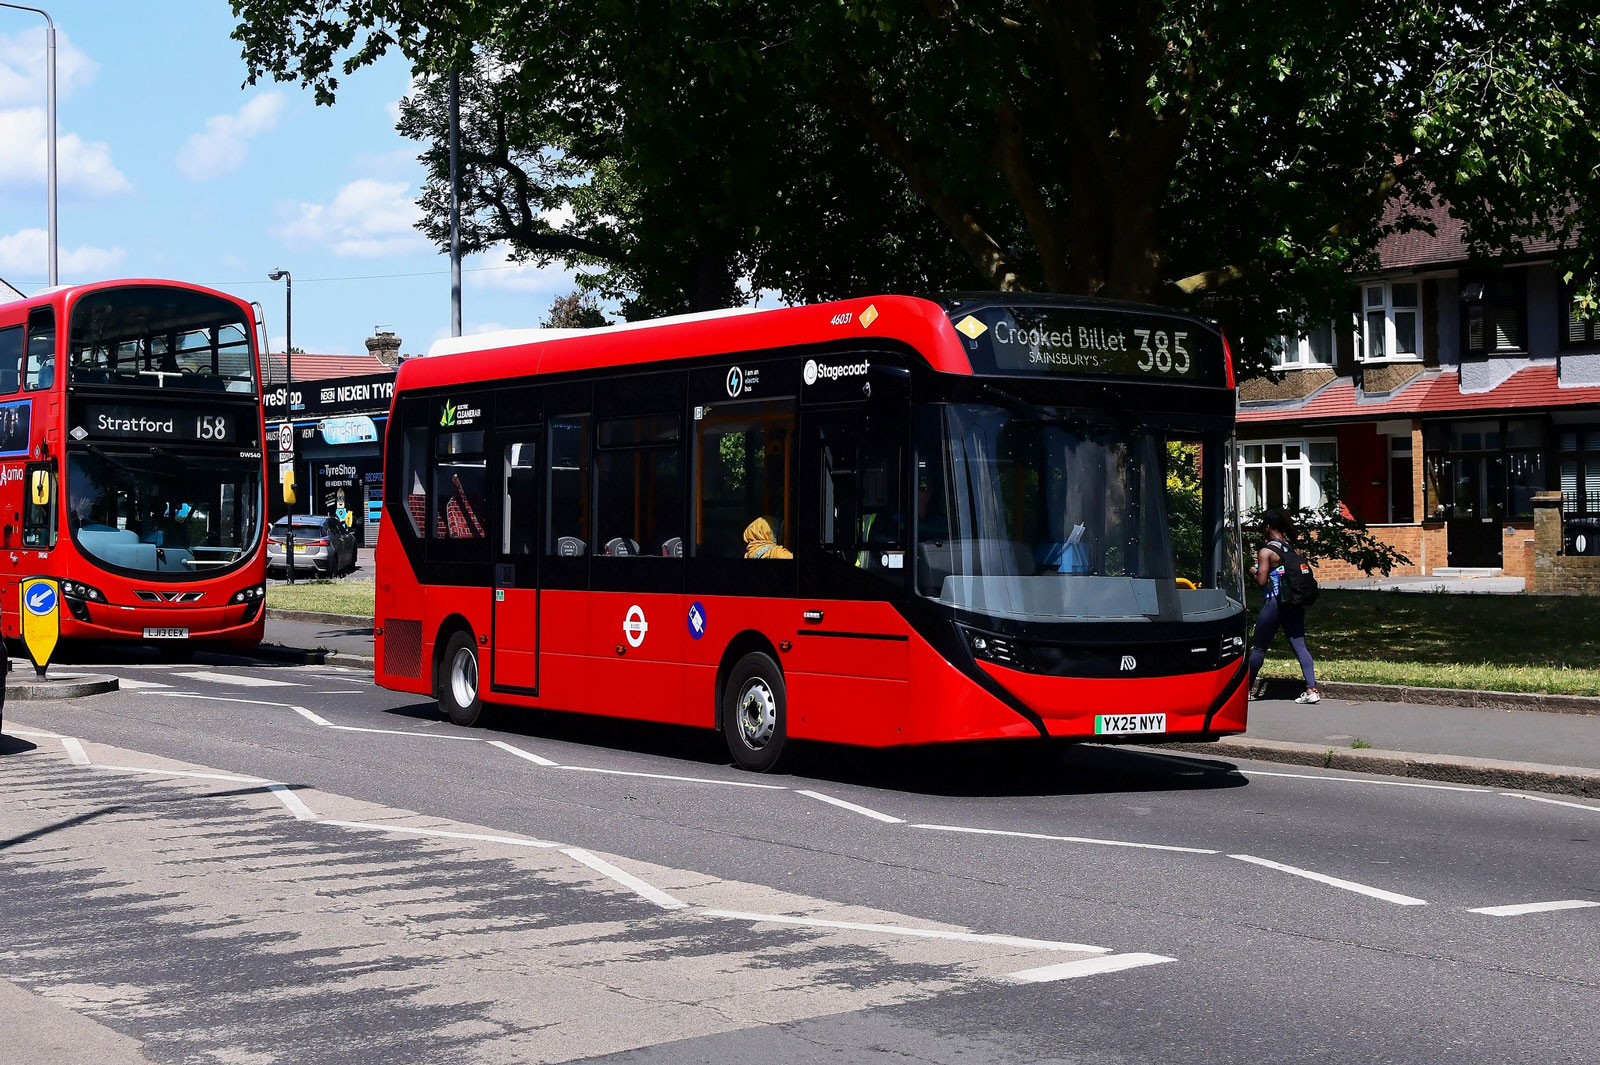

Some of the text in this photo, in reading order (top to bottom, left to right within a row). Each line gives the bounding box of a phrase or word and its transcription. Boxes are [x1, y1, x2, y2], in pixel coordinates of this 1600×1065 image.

[831, 313, 852, 325] 46031
[994, 320, 1190, 374] Crooked Billet 385
[1029, 351, 1099, 367] SAINSBURY'S
[338, 384, 370, 402] NEXEN
[372, 382, 396, 399] TYR
[98, 414, 226, 440] Stratford 158
[282, 434, 290, 444] 20
[8, 466, 24, 480] arriva
[324, 464, 356, 478] TyreShop
[148, 628, 184, 636] LJ13 CEX
[1104, 714, 1163, 732] YX25 NYY
